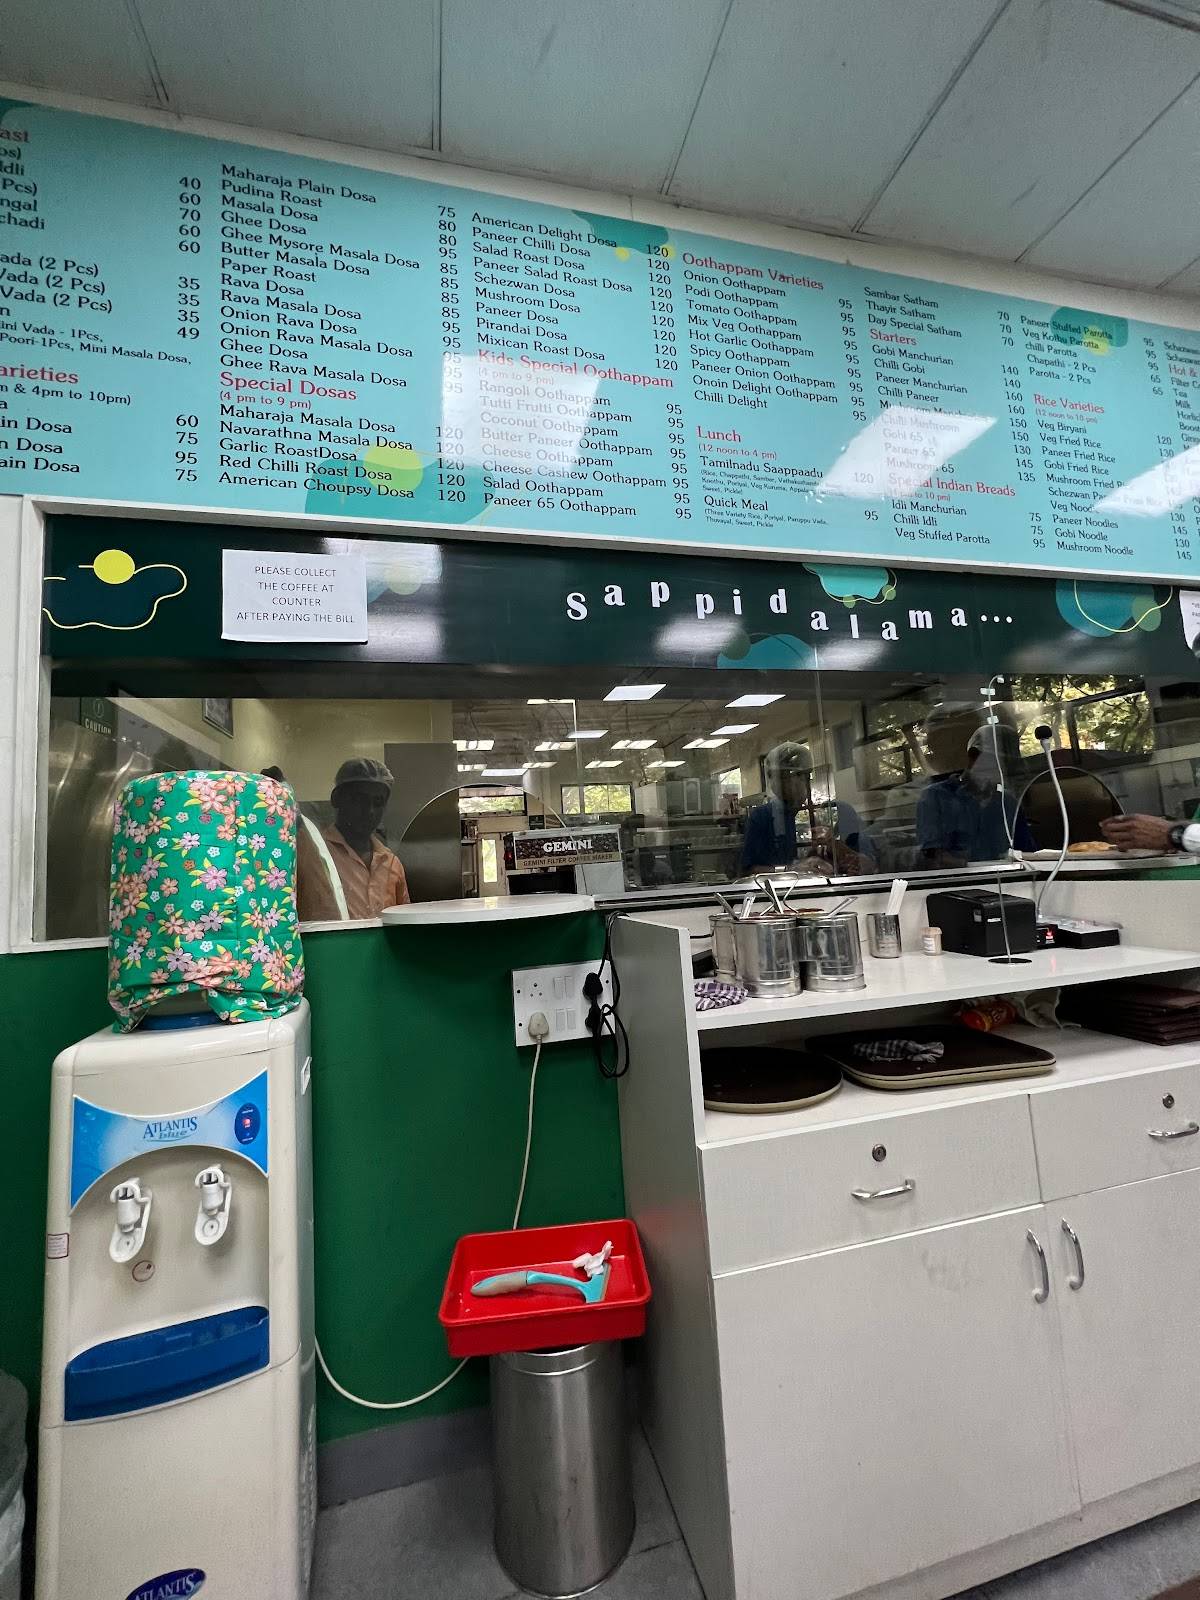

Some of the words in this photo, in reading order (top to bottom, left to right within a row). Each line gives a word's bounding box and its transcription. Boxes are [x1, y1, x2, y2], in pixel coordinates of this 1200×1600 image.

[179, 177, 201, 190] 40
[222, 164, 292, 187] Maharaja
[299, 179, 335, 195] Plain
[341, 186, 376, 203] Dosa
[222, 195, 274, 214] Masala
[281, 206, 318, 222] Dosa
[438, 206, 456, 218] 75
[472, 212, 533, 232] American
[538, 225, 582, 243] Delight
[588, 234, 617, 248] Dosa
[221, 226, 263, 243] Ghee
[269, 234, 324, 254] Mysore
[330, 243, 379, 262] Masala
[385, 253, 420, 269] Dosa
[439, 235, 456, 246] 80
[472, 227, 518, 243] Paneer
[523, 237, 555, 251] Chilli
[560, 243, 591, 257] Dosa
[221, 257, 267, 275] Paper
[274, 266, 317, 282] Roast
[440, 263, 458, 275] 85
[474, 257, 519, 273] Paneer
[524, 266, 558, 280] Salad
[563, 273, 598, 287] Roast
[602, 279, 632, 293] Dosa
[683, 253, 763, 277] Oothappam
[768, 269, 823, 290] Varieties
[474, 272, 538, 292] Schezwan
[544, 283, 575, 297] Dosa
[1, 285, 46, 303] Vada
[53, 293, 70, 307] (2
[78, 297, 113, 313] Pcs)
[475, 287, 544, 307] Mushroom
[550, 299, 580, 313] Dosa
[685, 285, 710, 297] Podi
[715, 290, 779, 309] Oothappam
[838, 298, 852, 309] 95
[864, 287, 900, 301] Sambar
[903, 295, 938, 308] Satham
[687, 299, 730, 314] Tomato
[734, 307, 797, 326] Oothappam
[998, 311, 1009, 320] 70
[177, 327, 199, 339] 49
[477, 318, 530, 335] Pirandai
[536, 326, 567, 341] Dosa
[688, 314, 708, 326] Mix
[712, 318, 734, 331] Veg
[739, 323, 801, 341] Oothappam
[868, 314, 887, 327] Day
[890, 318, 923, 331] Special
[927, 324, 961, 337] Satham
[220, 322, 270, 339] Onion
[277, 328, 314, 345] Rava
[321, 335, 371, 352] Masala
[377, 343, 413, 357] Dosa
[477, 333, 528, 350] Mixican
[534, 342, 569, 356] Roast
[574, 348, 605, 361] Dosa
[870, 329, 917, 345] Starters
[0, 333, 74, 351] Poori-1Pcs,
[80, 342, 107, 354] Mini
[112, 347, 153, 360] Masala
[158, 352, 191, 364] Dosa,
[478, 349, 513, 366] Kids
[520, 356, 577, 375] Special
[584, 365, 673, 387] Oothappam
[656, 359, 678, 371] 120
[1001, 365, 1018, 375] 140
[220, 372, 291, 393] Special
[300, 381, 357, 400] Dosas
[693, 375, 728, 388] Onoin
[733, 380, 771, 394] Delight
[776, 386, 838, 403] Oothappam
[876, 372, 909, 385] Paneer
[913, 378, 967, 393] Manchurian
[14, 384, 26, 393] &
[32, 386, 63, 398] 4pm
[69, 389, 82, 399] to
[90, 391, 131, 405] 10pm)
[695, 390, 723, 402] Chilli
[728, 395, 767, 409] Delight
[878, 386, 902, 398] Chilli
[907, 390, 939, 402] Paneer
[1034, 394, 1056, 407] Rice
[1060, 398, 1105, 414] Varieties
[220, 421, 312, 441] Navarathna
[319, 430, 370, 446] Masala
[376, 437, 412, 450] Dosa
[698, 426, 741, 442] Lunch
[1038, 419, 1055, 430] Veg
[1057, 422, 1086, 434] Biryani
[220, 438, 267, 453] Garlic
[275, 443, 357, 461] RoastDosa
[1040, 433, 1056, 444] Veg
[1060, 435, 1080, 446] Fried
[1084, 438, 1101, 448] Rice
[1042, 446, 1071, 458] Paneer
[1074, 448, 1095, 460] Fried
[1098, 452, 1115, 463] Rice
[220, 455, 250, 468] Red
[258, 458, 299, 473] Chilli
[306, 462, 348, 477] Roast
[355, 467, 392, 480] Dosa
[700, 456, 760, 472] Tamilnadu
[764, 463, 823, 478] Saappaadu
[219, 471, 297, 489] American
[304, 479, 371, 496] Choupsy
[378, 485, 414, 498] Dosa
[937, 479, 972, 492] Indian
[977, 482, 1016, 496] Breads
[438, 490, 466, 502] 120
[484, 493, 531, 507] Paneer
[537, 498, 554, 509] 65
[560, 500, 637, 515] Oothappam
[704, 496, 737, 509] Quick
[742, 500, 768, 511] Meal
[676, 508, 691, 519] 95
[894, 514, 919, 524] Chilli
[923, 516, 937, 526] Idli
[895, 528, 915, 539] Veg
[919, 530, 952, 541] Stuffed
[956, 533, 990, 544] Parotta
[1033, 539, 1045, 548] 95
[1055, 528, 1075, 538] Gobi
[1079, 531, 1108, 541] Noodle
[1175, 539, 1190, 548] 130
[1057, 541, 1101, 552] Mushroom
[1105, 545, 1133, 555] Noodle
[1177, 551, 1192, 560] 145
[255, 566, 291, 575] PLEASE
[295, 568, 336, 577] COLLECT
[258, 582, 277, 590] THE
[281, 583, 318, 591] COFFEE
[322, 584, 334, 592] AT
[272, 597, 321, 606] COUNTER
[237, 612, 268, 620] AFTER
[273, 613, 310, 622] PAYING
[313, 614, 332, 622] THE
[543, 840, 593, 852] GEMINI
[143, 1116, 198, 1139] ATLANTIS
